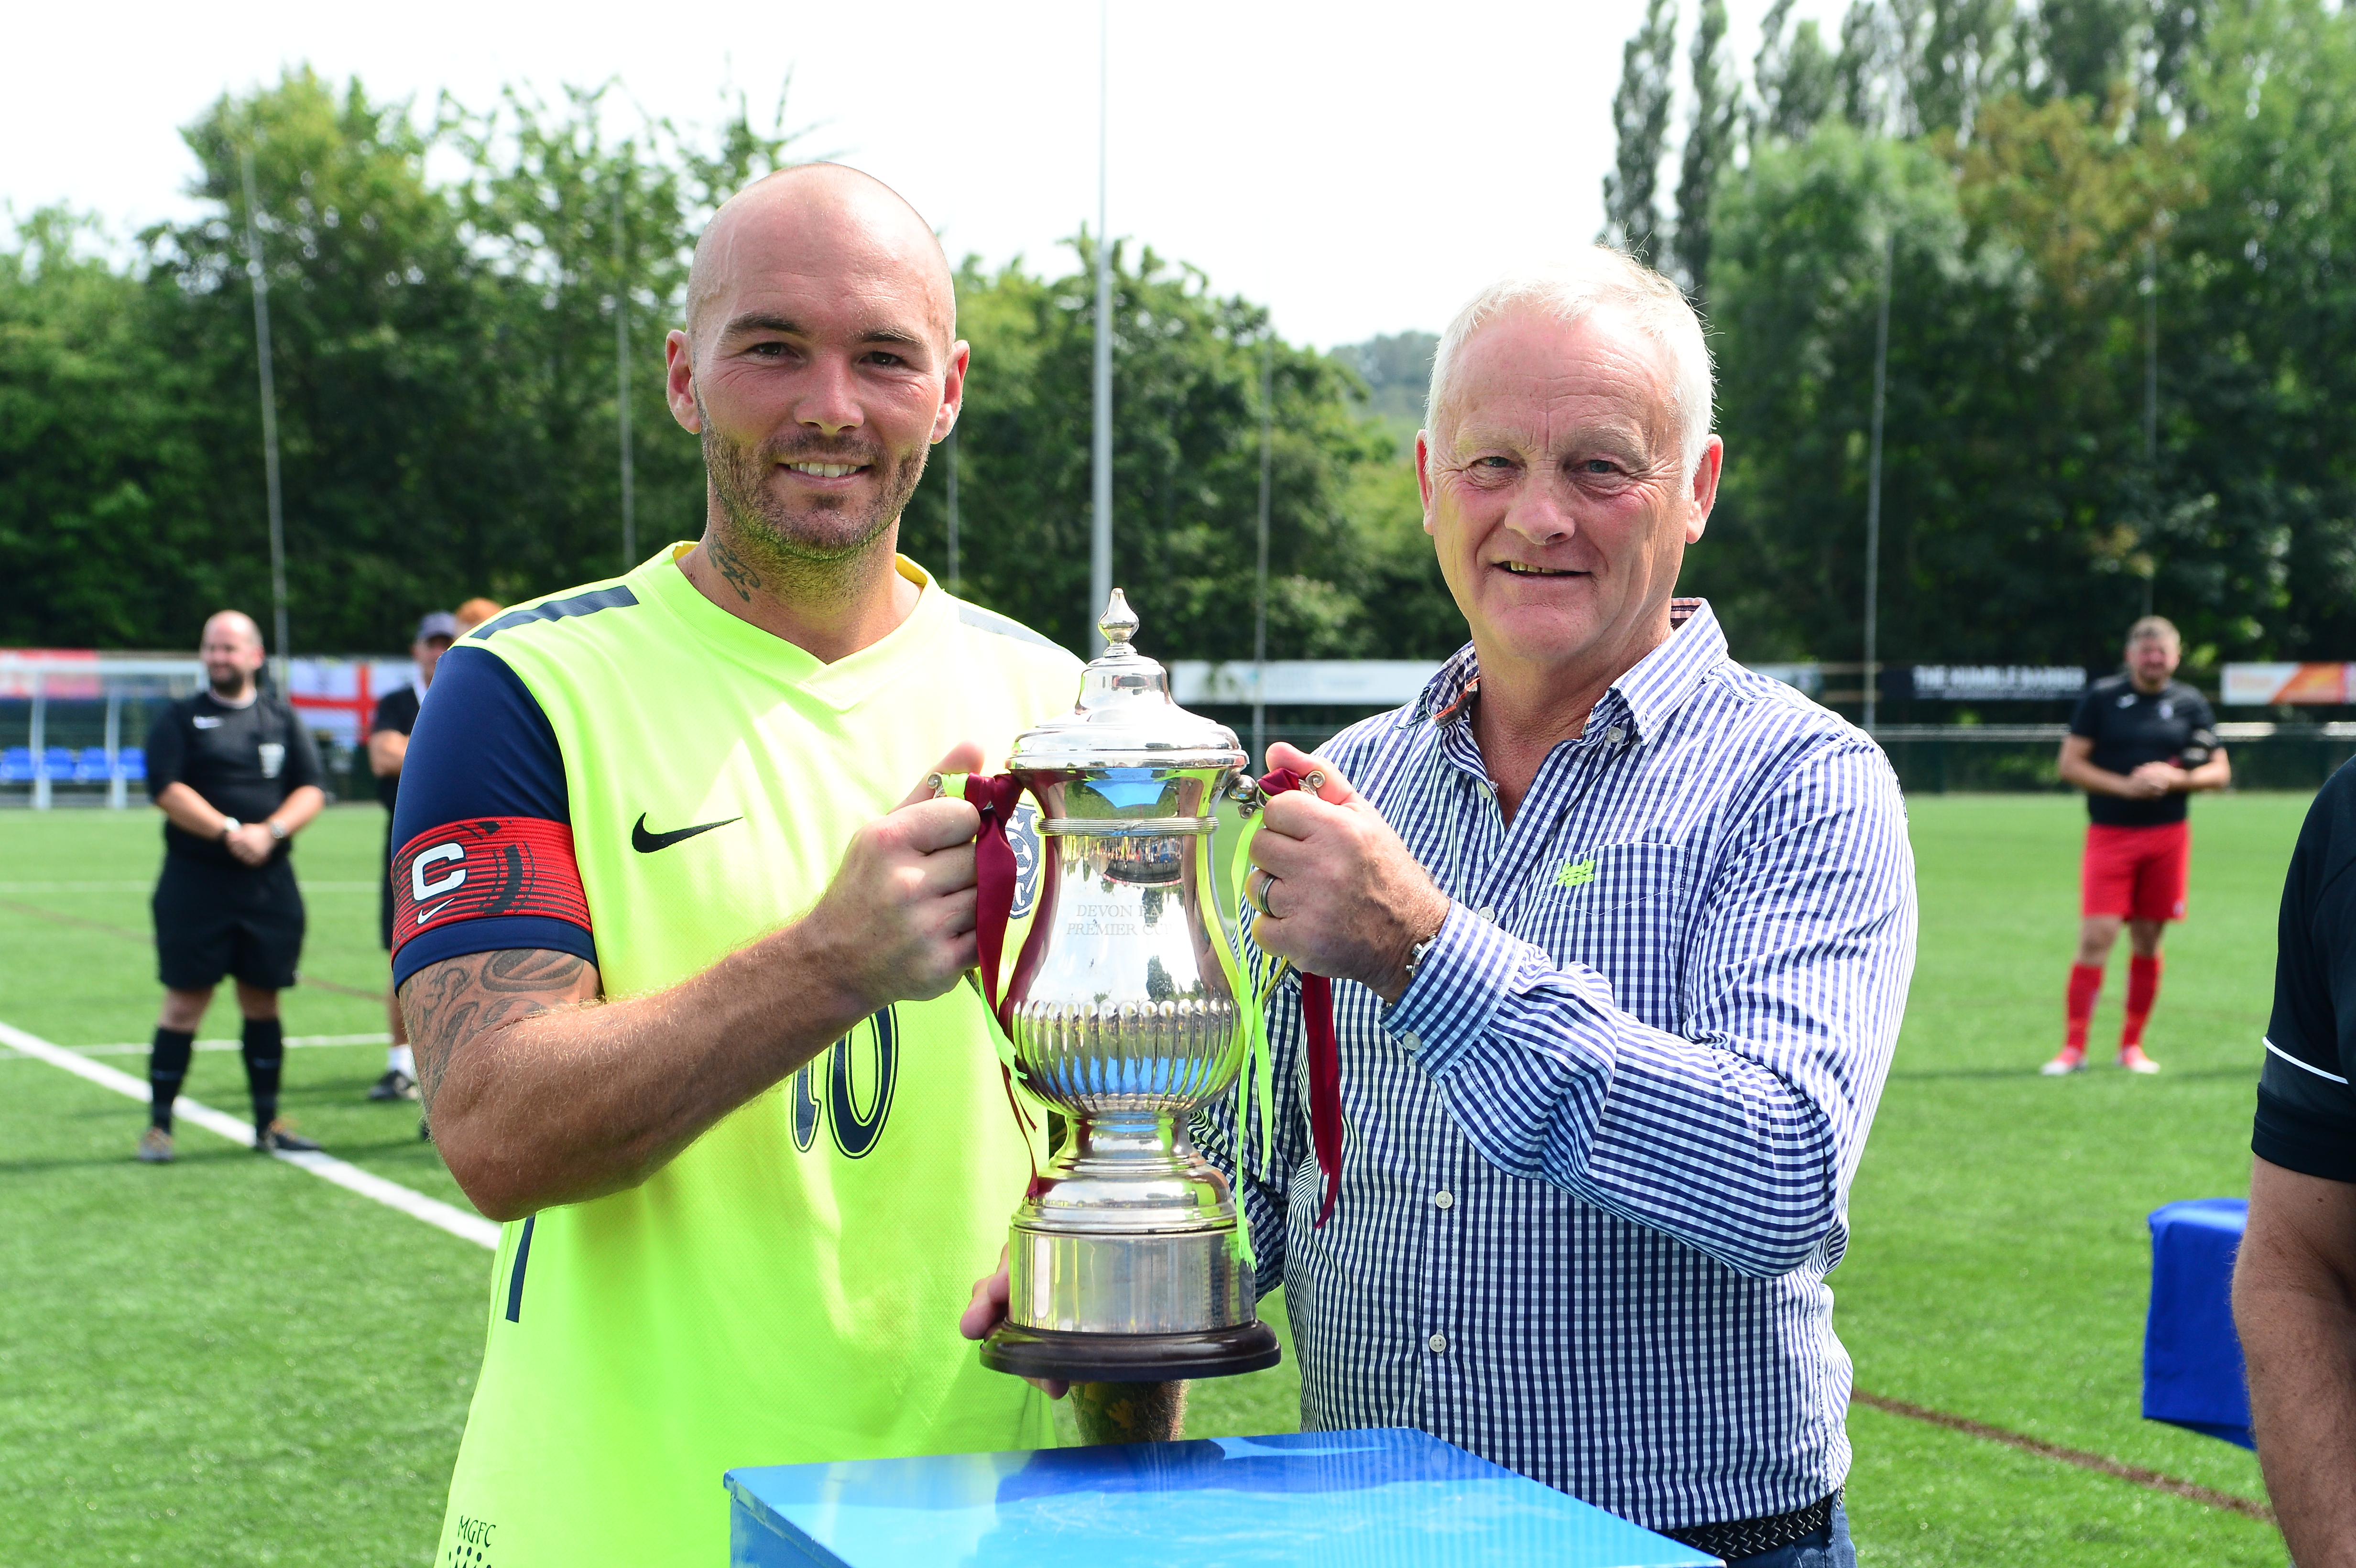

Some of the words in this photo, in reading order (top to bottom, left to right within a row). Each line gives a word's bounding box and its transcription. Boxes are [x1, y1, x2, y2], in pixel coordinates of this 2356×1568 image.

[412, 842, 467, 901] C
[1075, 904, 1133, 917] DEVON
[1066, 923, 1138, 935] PREMIER
[1143, 923, 1172, 935] CUP
[458, 1514, 497, 1548] MGFC
